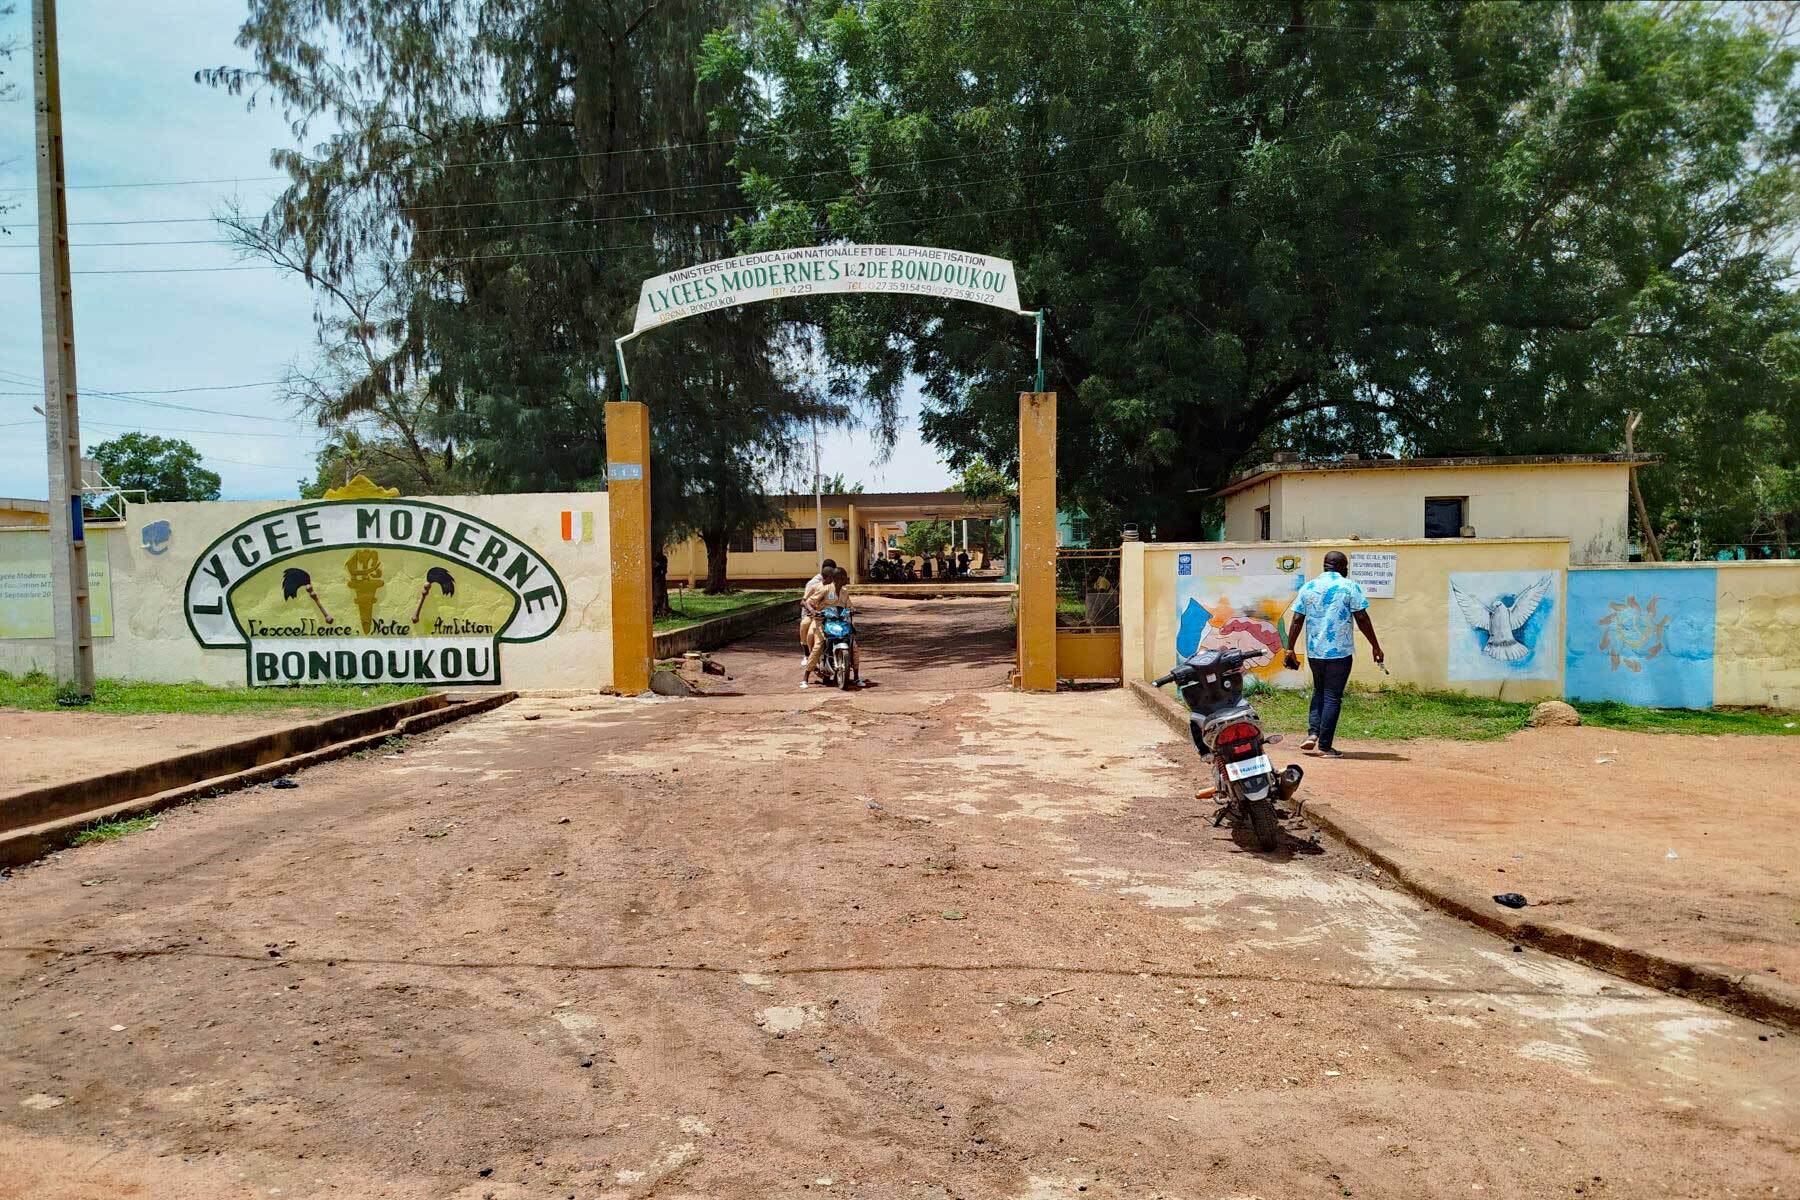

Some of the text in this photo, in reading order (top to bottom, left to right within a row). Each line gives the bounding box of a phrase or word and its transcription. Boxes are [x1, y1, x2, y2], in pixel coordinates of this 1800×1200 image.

[669, 247, 986, 284] MINISTERE DE L'EDUCATION NATIONALE ET DE L'ALPHABETISATION
[648, 275, 718, 314] LYCEES
[721, 259, 840, 293] MODERNES
[866, 260, 888, 278] DE
[891, 259, 1007, 294] BONDOUKOU
[690, 295, 736, 313] BONDOUKOU
[789, 283, 813, 295] 429
[192, 508, 560, 616] LYCEE MODERNE
[370, 618, 411, 636] Notre
[256, 647, 490, 682] BONDOUKOU
